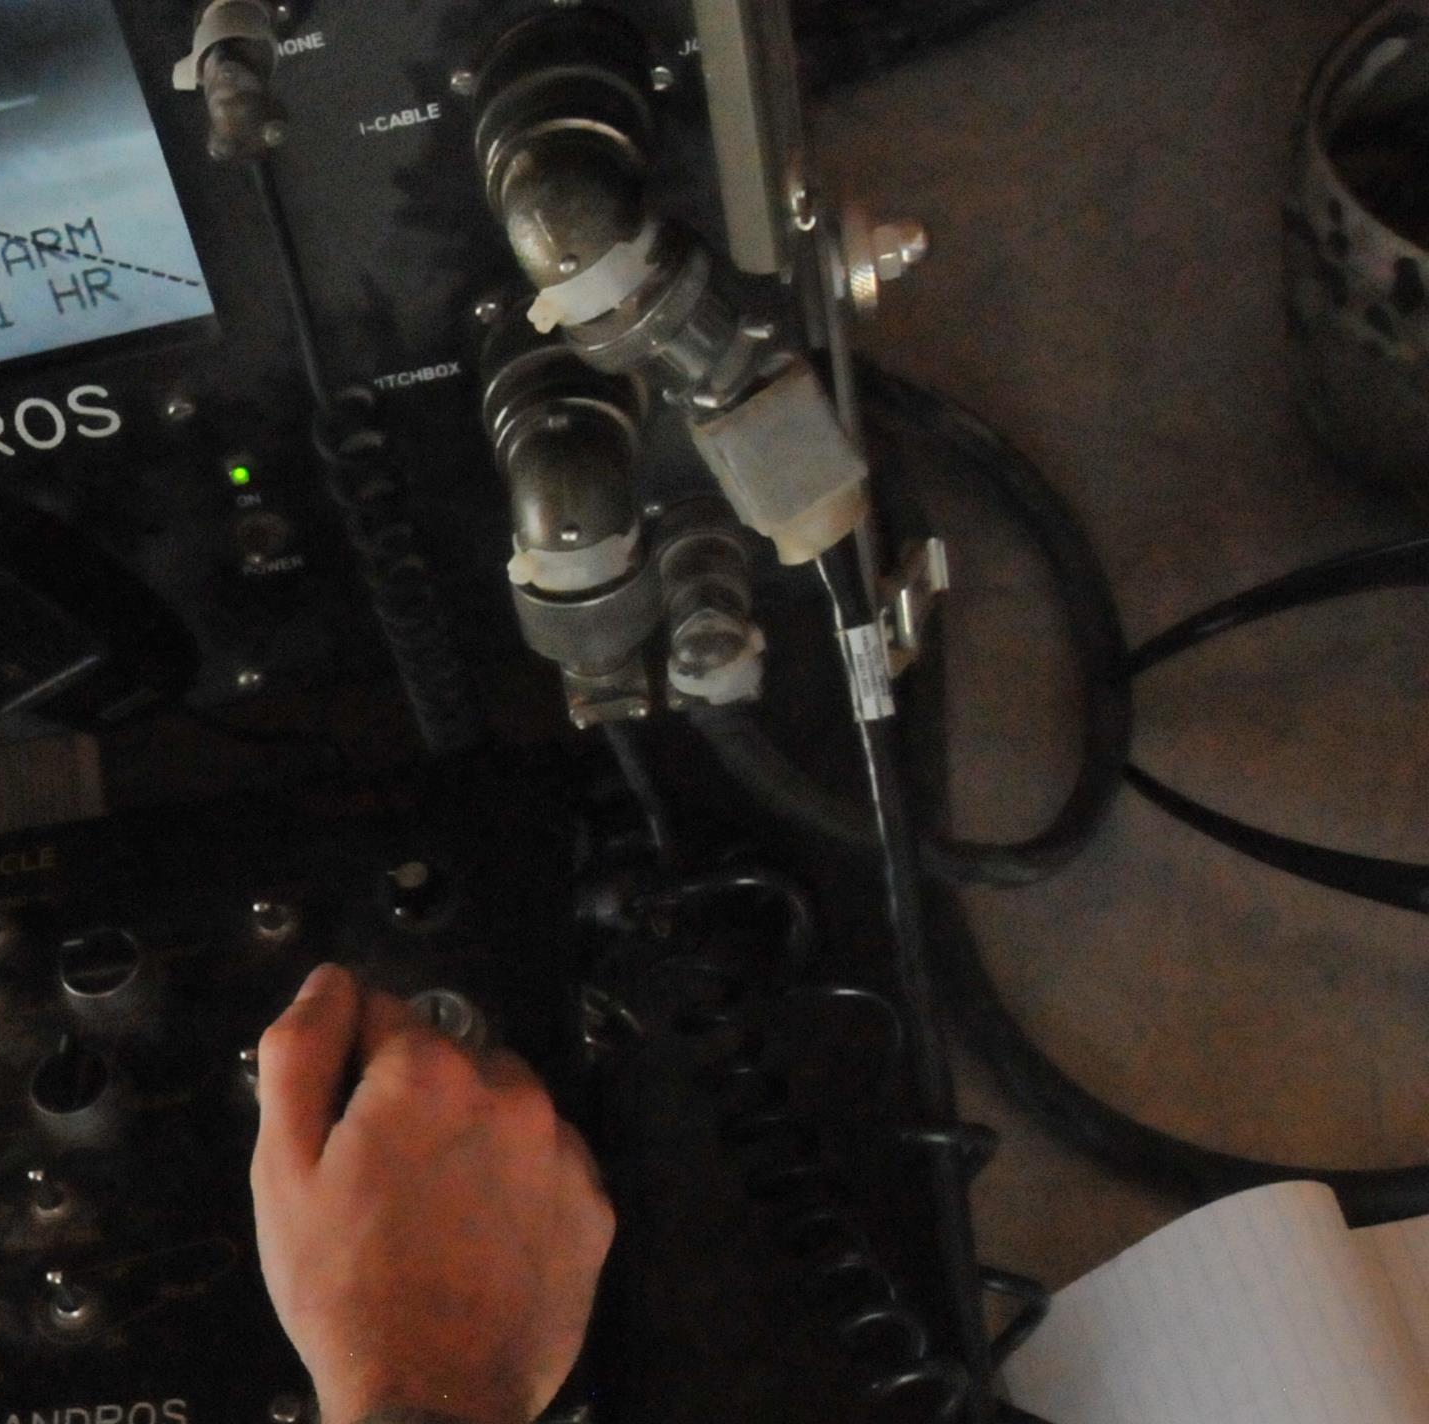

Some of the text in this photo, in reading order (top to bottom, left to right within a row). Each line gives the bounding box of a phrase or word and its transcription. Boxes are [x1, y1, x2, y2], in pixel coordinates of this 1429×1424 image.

[0, 216, 104, 277] ARM
[48, 266, 120, 315] HR
[374, 361, 461, 390] ITCHBOX
